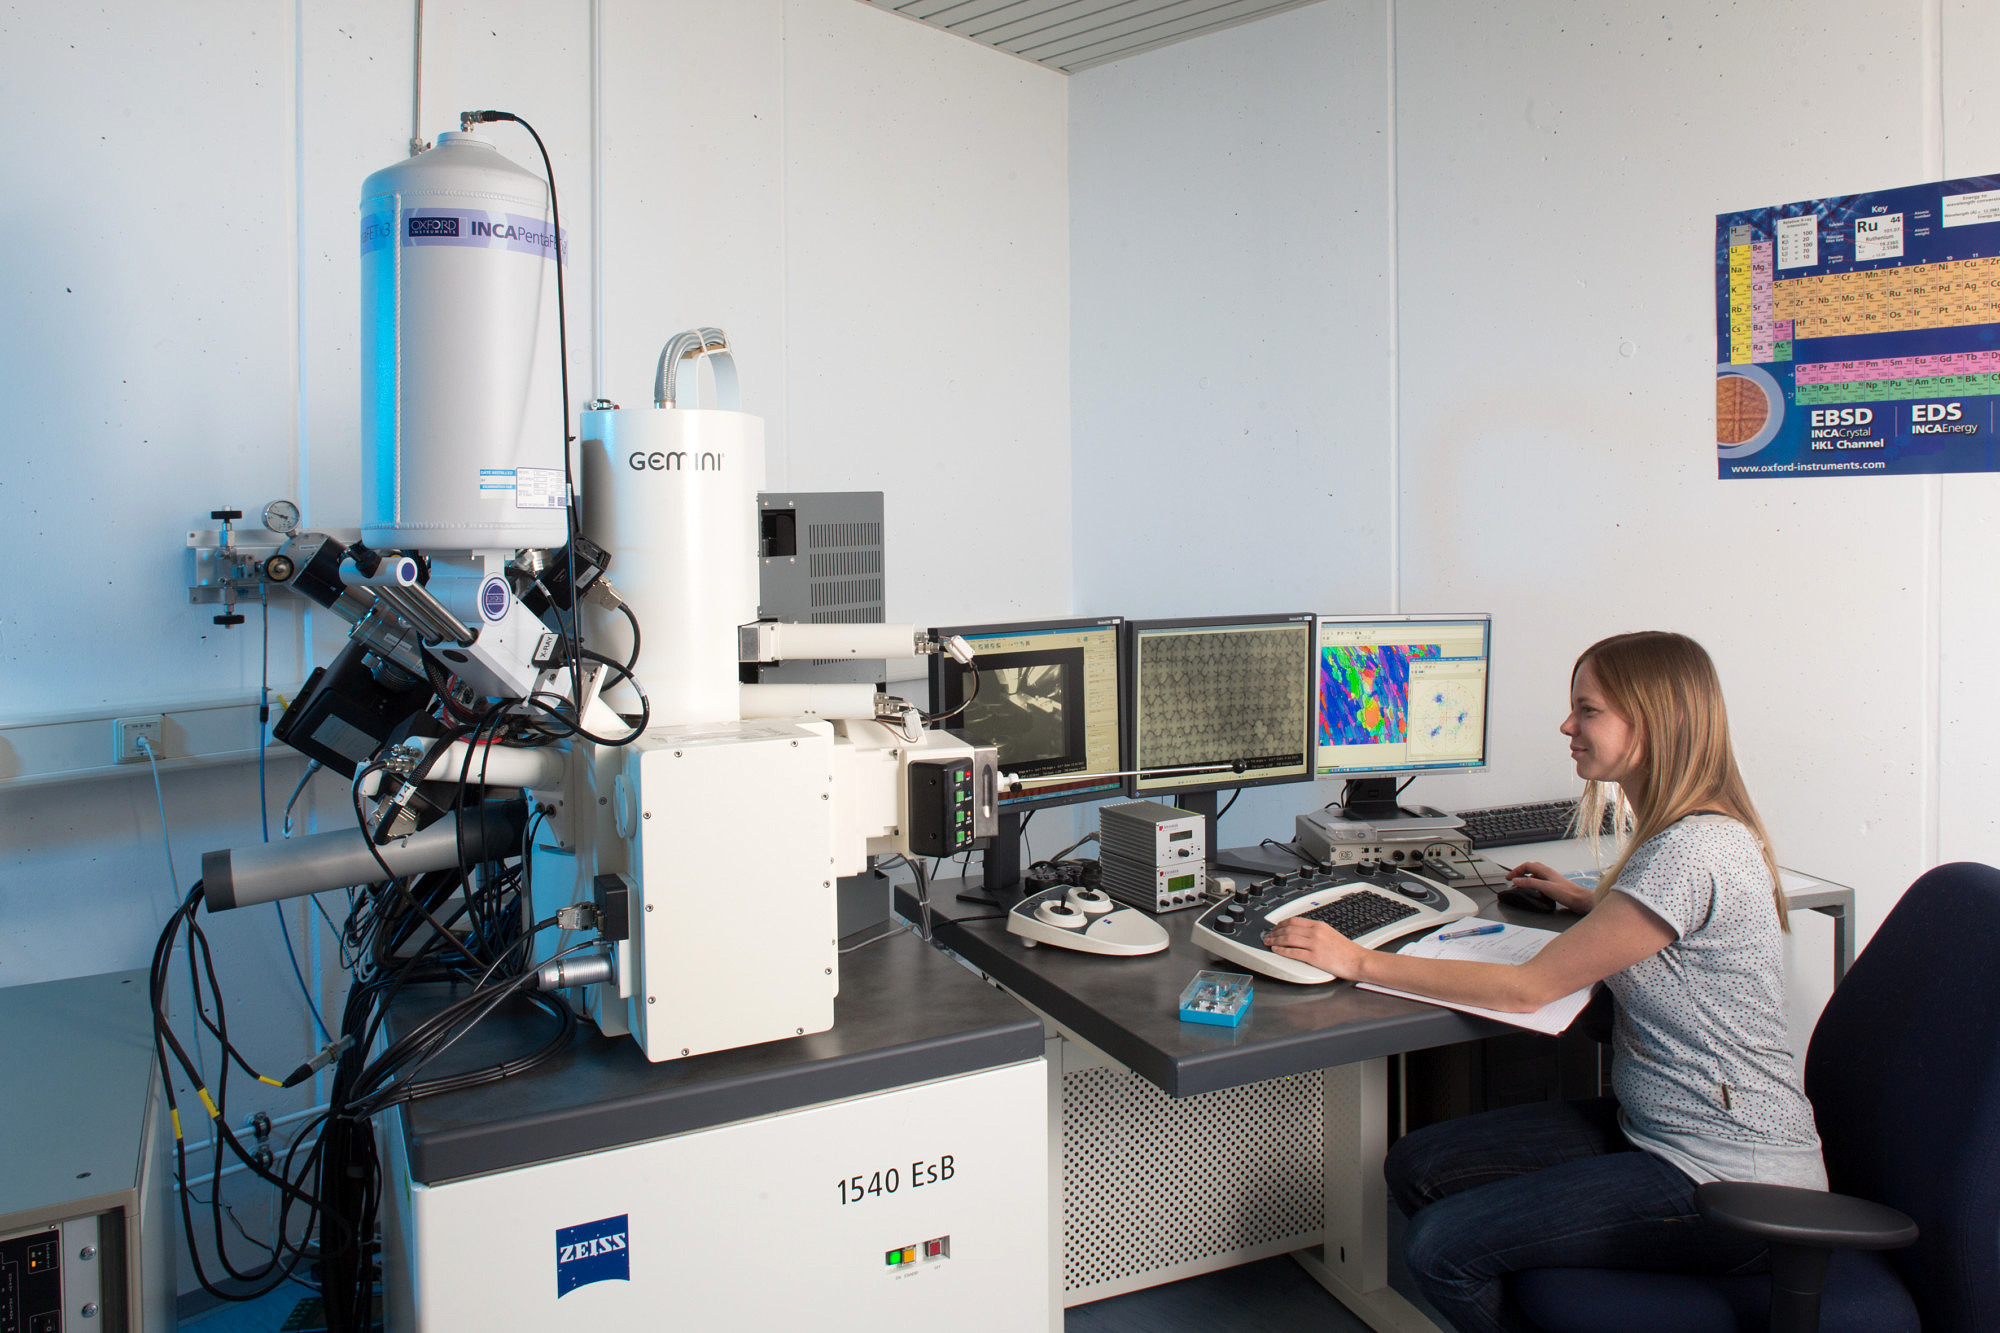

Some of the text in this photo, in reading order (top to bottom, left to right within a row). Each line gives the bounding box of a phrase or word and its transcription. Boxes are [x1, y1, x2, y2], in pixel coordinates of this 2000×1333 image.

[1872, 205, 1888, 214] Key
[411, 220, 456, 230] OXFORD
[1857, 221, 1878, 233] Ru
[1964, 282, 1977, 292] Ag
[1866, 382, 1878, 390] Np
[1810, 408, 1873, 427] EBSD
[1912, 402, 1962, 422] EDS
[1811, 427, 1872, 439] INCACrystal
[1912, 424, 1978, 435] INCAEnergy
[1811, 438, 1884, 450] HKL Channel
[628, 452, 722, 471] GEMINI
[1731, 460, 1886, 474] www.oxford-instruments.com
[540, 636, 554, 659] X-RAY
[837, 1154, 955, 1206] 1540 EsB
[560, 1232, 626, 1264] ZEISS
